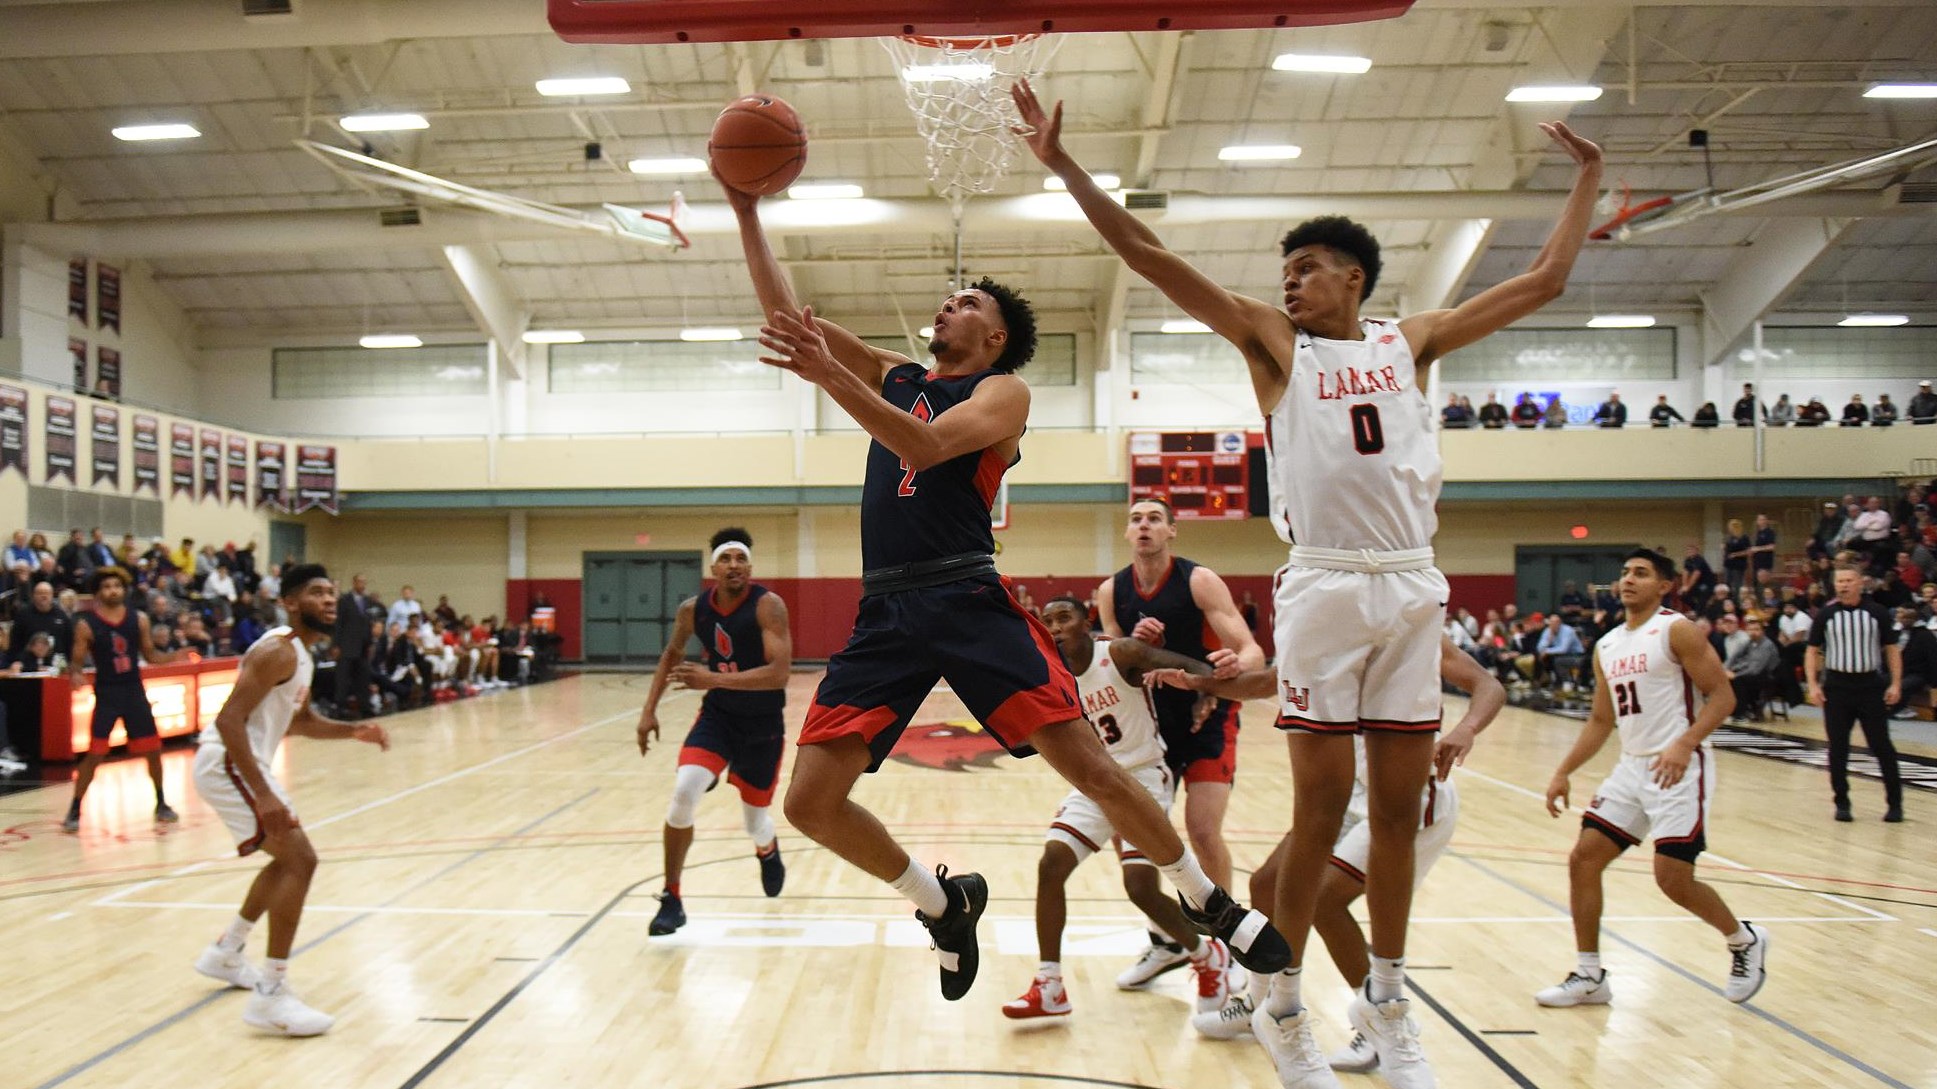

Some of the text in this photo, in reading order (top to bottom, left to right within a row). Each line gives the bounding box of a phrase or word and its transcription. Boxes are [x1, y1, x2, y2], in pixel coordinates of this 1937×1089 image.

[1317, 365, 1401, 400] LAMAR
[1349, 403, 1385, 456] 0
[898, 457, 917, 497] 2
[1084, 685, 1120, 714] MAR
[1614, 681, 1642, 717] 21
